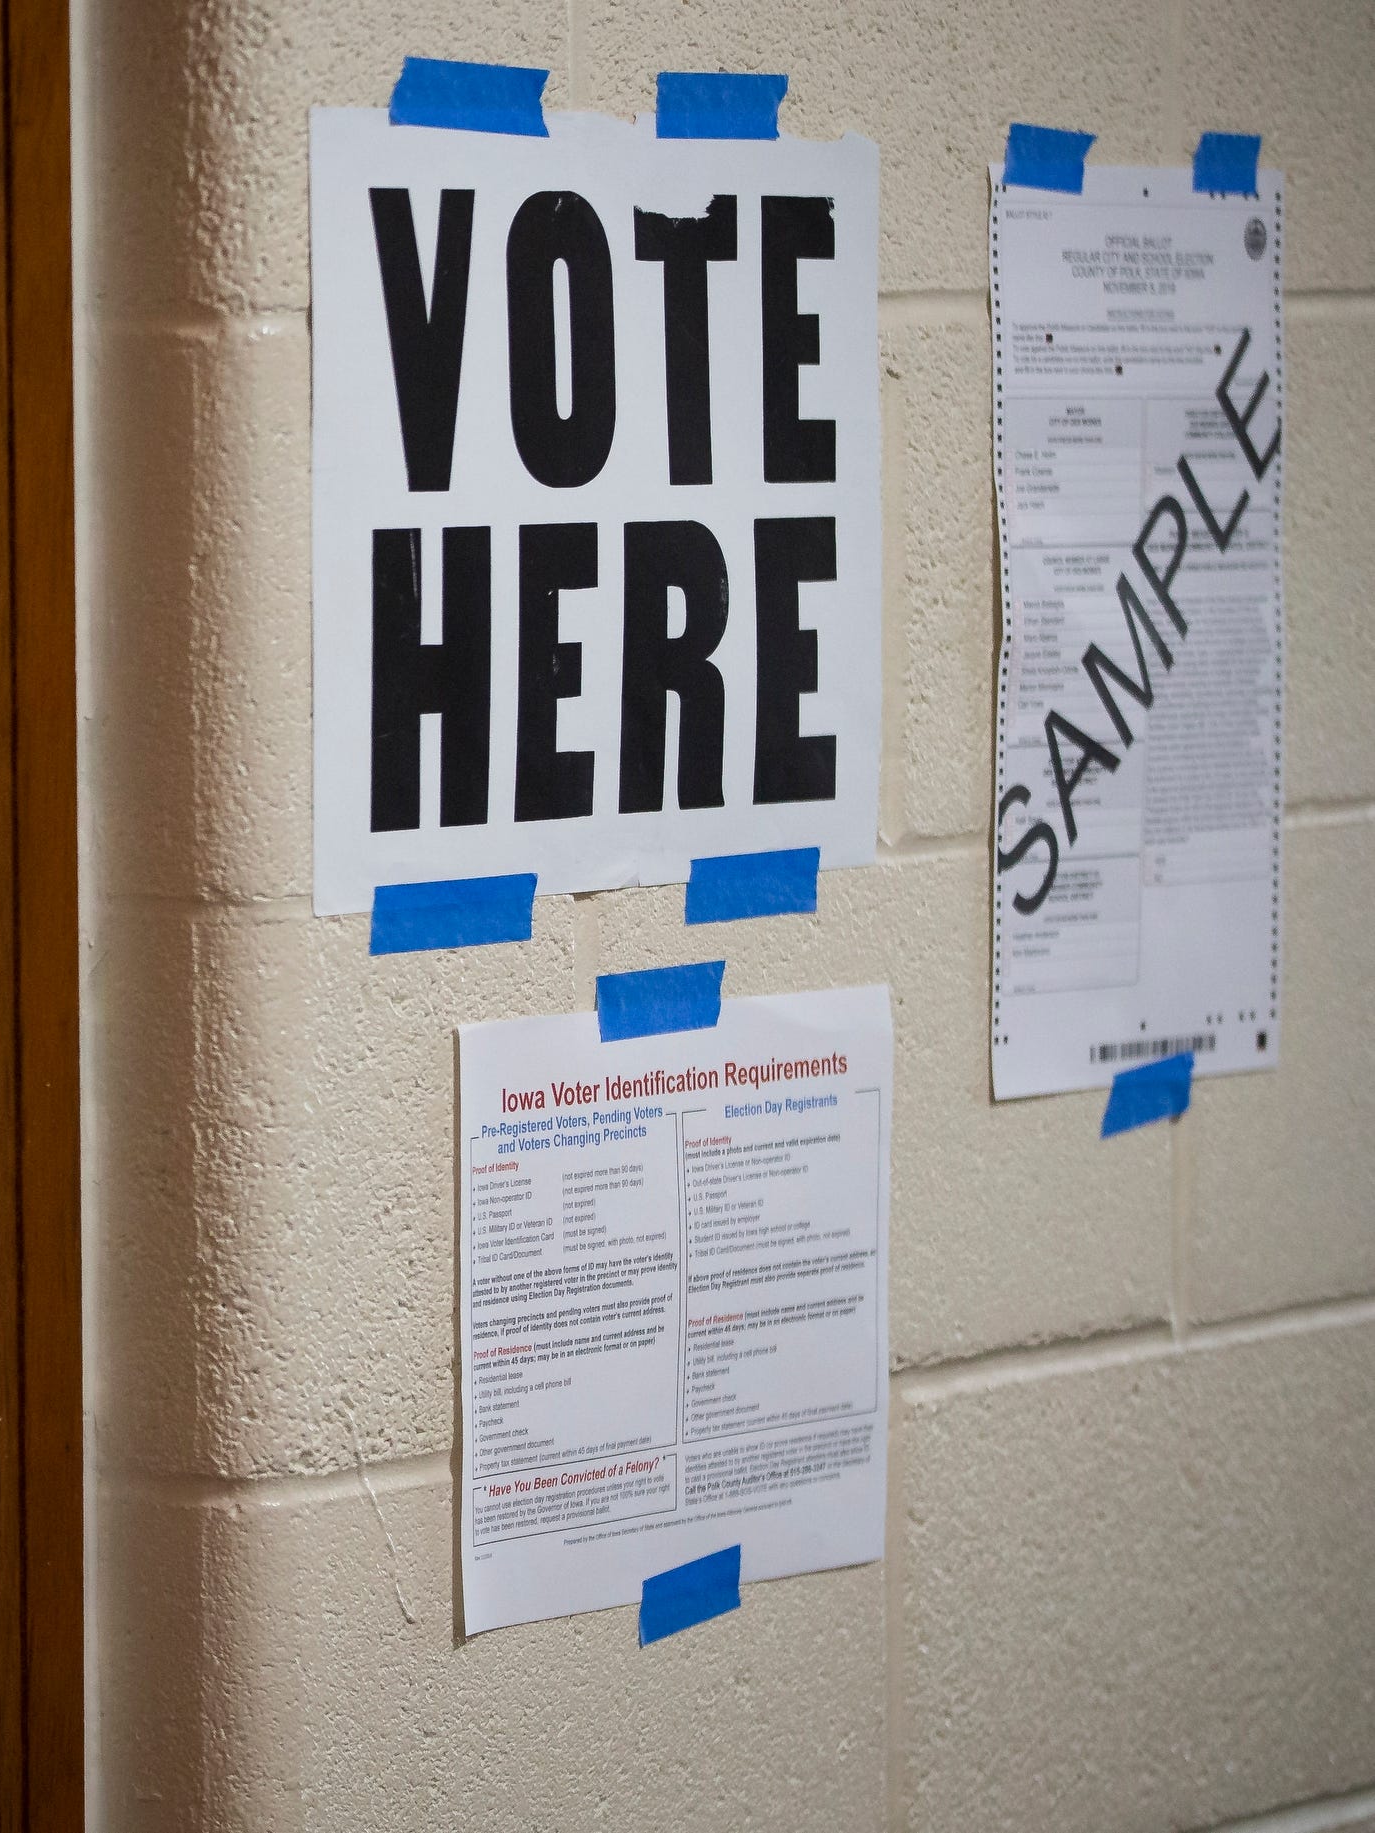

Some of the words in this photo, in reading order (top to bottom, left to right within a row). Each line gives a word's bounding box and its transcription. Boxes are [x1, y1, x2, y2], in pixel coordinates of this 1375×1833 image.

[369, 188, 836, 492] VOTE
[998, 328, 1280, 915] SAMPLE
[371, 517, 837, 832] HERE
[502, 1088, 545, 1113] Iowa
[551, 1082, 600, 1107] Voter
[606, 1066, 718, 1101] Identification
[725, 1051, 847, 1089] Requirements
[725, 1102, 762, 1118] Election
[764, 1100, 783, 1118] Day
[785, 1094, 838, 1115] Registrants
[481, 1118, 553, 1142] Pre-Registered
[554, 1114, 589, 1132] Voters,
[591, 1109, 631, 1129] Pending
[632, 1106, 663, 1121] Voters
[497, 1139, 517, 1154] and
[518, 1135, 550, 1152] Voters
[551, 1130, 600, 1151] Changing
[601, 1125, 647, 1142] Precincts
[685, 1138, 701, 1149] Proof
[702, 1138, 708, 1147] of
[709, 1135, 731, 1148] Identity
[472, 1165, 487, 1175] Proof
[487, 1164, 494, 1173] of
[495, 1162, 519, 1175] Identity
[477, 1183, 488, 1192] Iowa
[509, 1177, 532, 1188] License
[488, 1208, 512, 1221] Passport
[477, 1240, 489, 1249] Iowa
[489, 1238, 503, 1248] Voter
[504, 1234, 540, 1246] Identification
[540, 1232, 554, 1242] Card
[473, 1277, 476, 1286] A
[476, 1275, 490, 1285] voter
[490, 1273, 512, 1283] without
[525, 1270, 532, 1279] of
[532, 1268, 543, 1278] the
[543, 1266, 562, 1276] above
[562, 1264, 580, 1274] forms
[580, 1263, 587, 1271] of
[587, 1262, 594, 1270] ID
[595, 1262, 607, 1271] may
[608, 1258, 622, 1268] have
[622, 1257, 632, 1266] the
[652, 1251, 673, 1264] identity
[492, 1286, 499, 1295] to
[499, 1285, 508, 1296] by
[508, 1282, 532, 1293] another
[532, 1278, 563, 1291] registered
[563, 1275, 578, 1285] voter
[578, 1274, 585, 1283] in
[586, 1273, 596, 1282] the
[596, 1270, 619, 1283] precinct
[627, 1269, 639, 1279] may
[640, 1267, 656, 1277] prove
[656, 1262, 677, 1275] identity
[472, 1299, 482, 1308] and
[482, 1295, 510, 1307] residence
[510, 1293, 527, 1305] using
[527, 1290, 553, 1301] Election
[553, 1288, 565, 1299] Day
[565, 1283, 601, 1298] Registration
[489, 1315, 516, 1328] changing
[516, 1311, 545, 1325] precincts
[545, 1309, 557, 1319] and
[557, 1306, 582, 1319] pending
[582, 1303, 600, 1314] voters
[600, 1301, 616, 1311] must
[616, 1299, 628, 1309] also
[628, 1296, 650, 1309] provide
[650, 1294, 666, 1306] proof
[666, 1293, 673, 1302] of
[500, 1328, 504, 1336] if
[505, 1325, 521, 1337] proof
[522, 1324, 529, 1333] of
[529, 1321, 552, 1334] identity
[552, 1319, 568, 1329] does
[568, 1317, 579, 1327] not
[579, 1314, 601, 1325] contain
[621, 1308, 641, 1319] current
[688, 1316, 704, 1327] Proof
[705, 1315, 712, 1324] of
[712, 1311, 743, 1323] Residence
[551, 1337, 573, 1349] include
[573, 1337, 590, 1345] name
[590, 1333, 601, 1343] and
[602, 1330, 622, 1341] current
[623, 1327, 645, 1338] address
[645, 1326, 657, 1335] and
[657, 1324, 664, 1333] be
[473, 1349, 489, 1359] Proof
[489, 1348, 496, 1357] of
[497, 1343, 532, 1356] Residence
[492, 1357, 510, 1368] within
[510, 1356, 519, 1365] 45
[536, 1353, 550, 1363] may
[550, 1351, 559, 1360] be
[559, 1350, 565, 1358] in
[574, 1344, 602, 1356] electronic
[603, 1342, 621, 1352] format
[622, 1342, 628, 1350] or
[629, 1341, 637, 1349] on
[637, 1337, 655, 1349] paper)
[478, 1372, 507, 1384] Residential
[507, 1370, 523, 1380] lease
[478, 1416, 503, 1429] Paycheck
[488, 1482, 513, 1497] Have
[514, 1479, 532, 1493] You
[533, 1474, 559, 1490] Been
[560, 1467, 606, 1486] Convicted
[607, 1465, 616, 1478] of
[617, 1467, 624, 1476] a
[625, 1457, 660, 1478] Felony?
